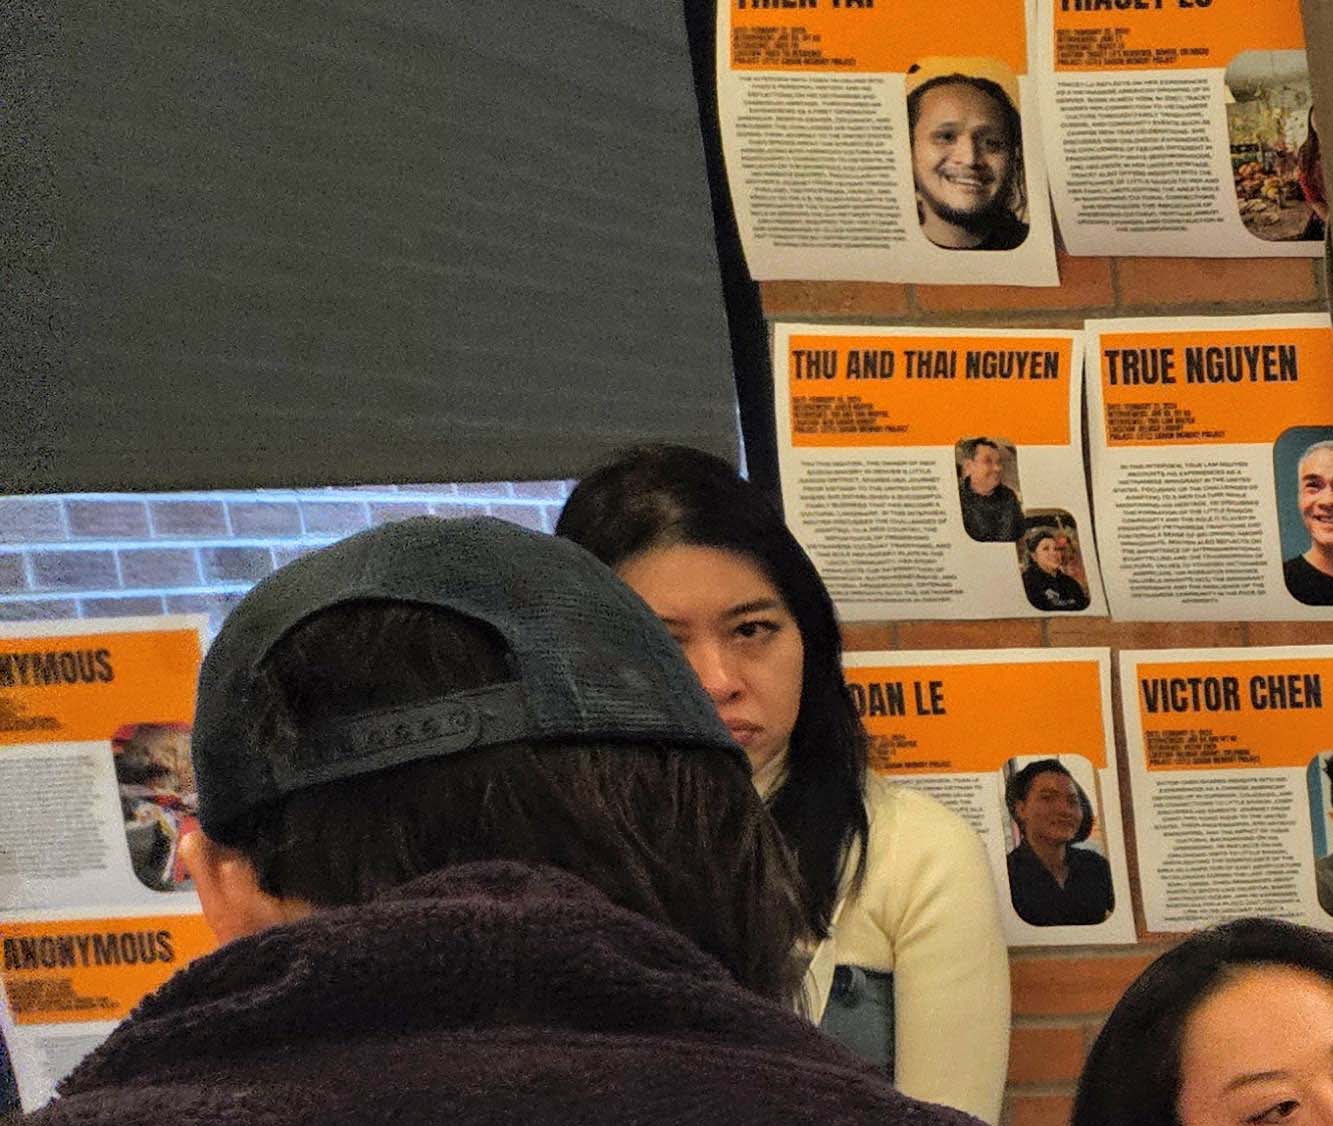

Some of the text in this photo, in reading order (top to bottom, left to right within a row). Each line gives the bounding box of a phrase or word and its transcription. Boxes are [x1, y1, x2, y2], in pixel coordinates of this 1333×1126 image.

[793, 350, 1059, 379] THU AND THAI NGUYEN
[1104, 345, 1299, 385] TRUE NGUYEN
[847, 680, 947, 717] OAN LE
[1142, 674, 1322, 713] VICTOR CHEN
[3, 930, 175, 970] ANONYMOUS
